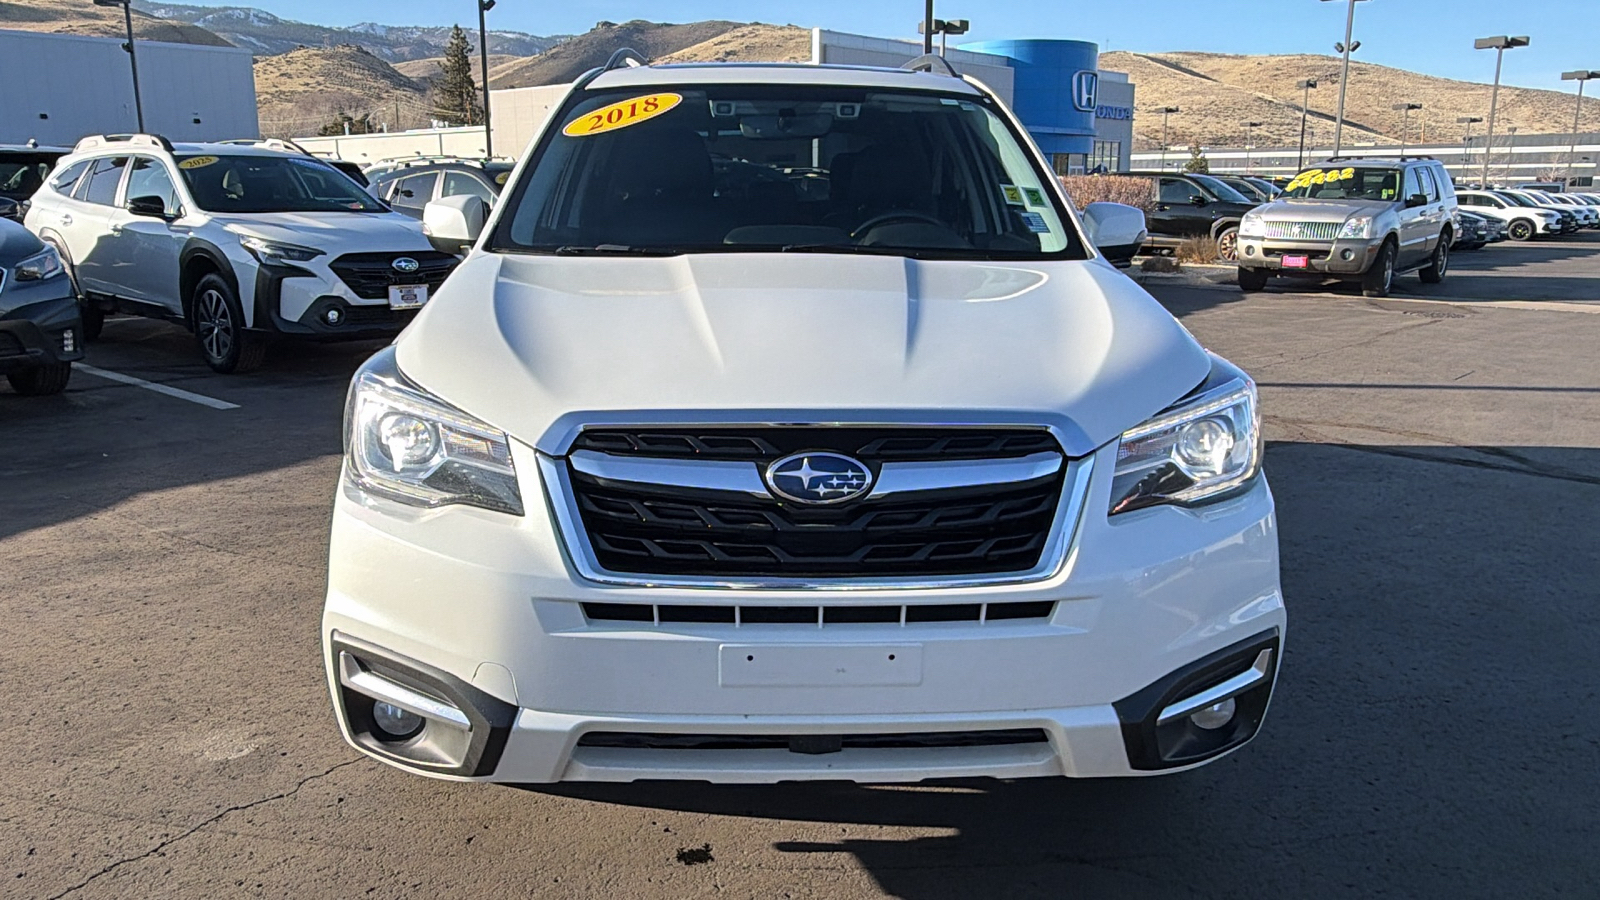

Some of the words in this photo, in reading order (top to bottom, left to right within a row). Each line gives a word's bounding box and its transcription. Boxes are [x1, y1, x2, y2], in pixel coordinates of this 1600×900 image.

[588, 97, 659, 131] 2018
[1095, 105, 1131, 119] ONDA
[186, 157, 213, 168] 2025
